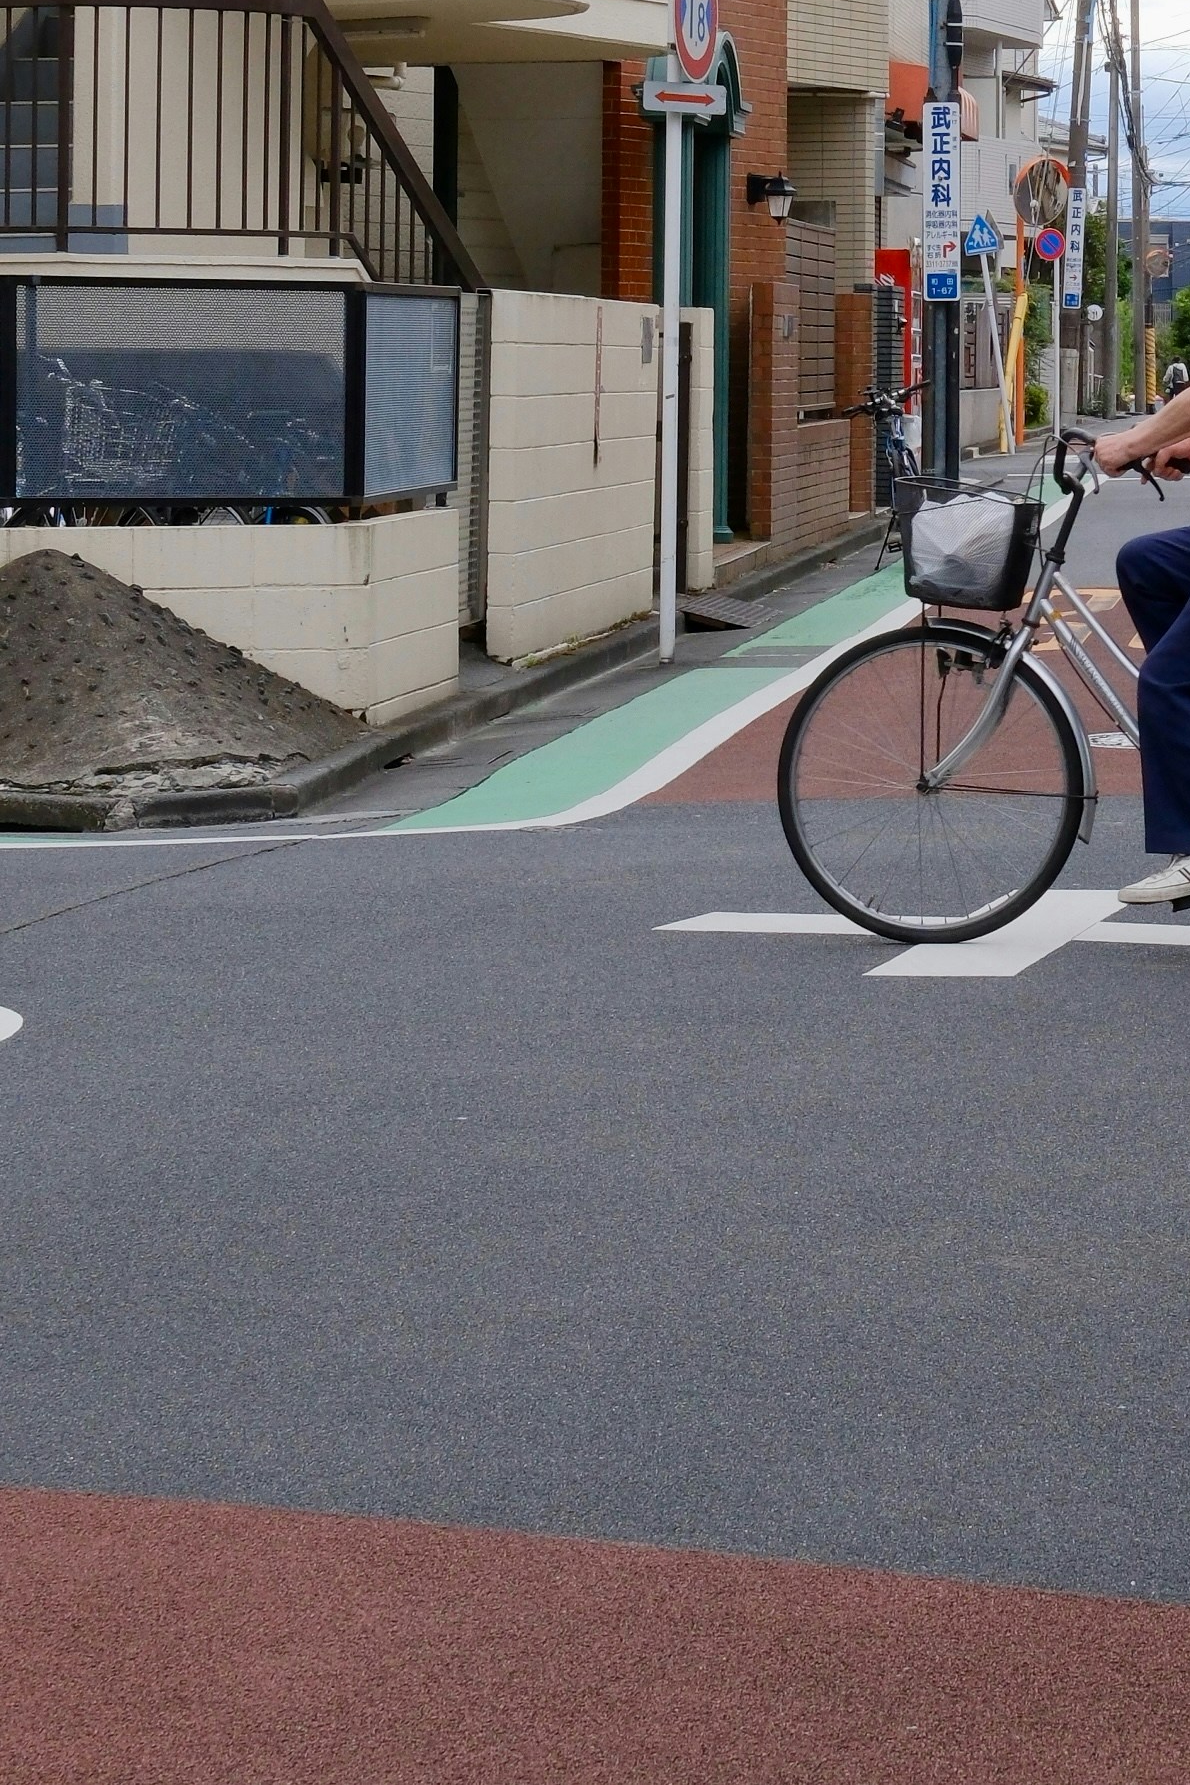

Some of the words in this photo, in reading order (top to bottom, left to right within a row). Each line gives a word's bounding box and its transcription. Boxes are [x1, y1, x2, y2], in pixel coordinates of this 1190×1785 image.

[931, 106, 951, 207] 武正内科
[1069, 189, 1083, 253] 武正内科
